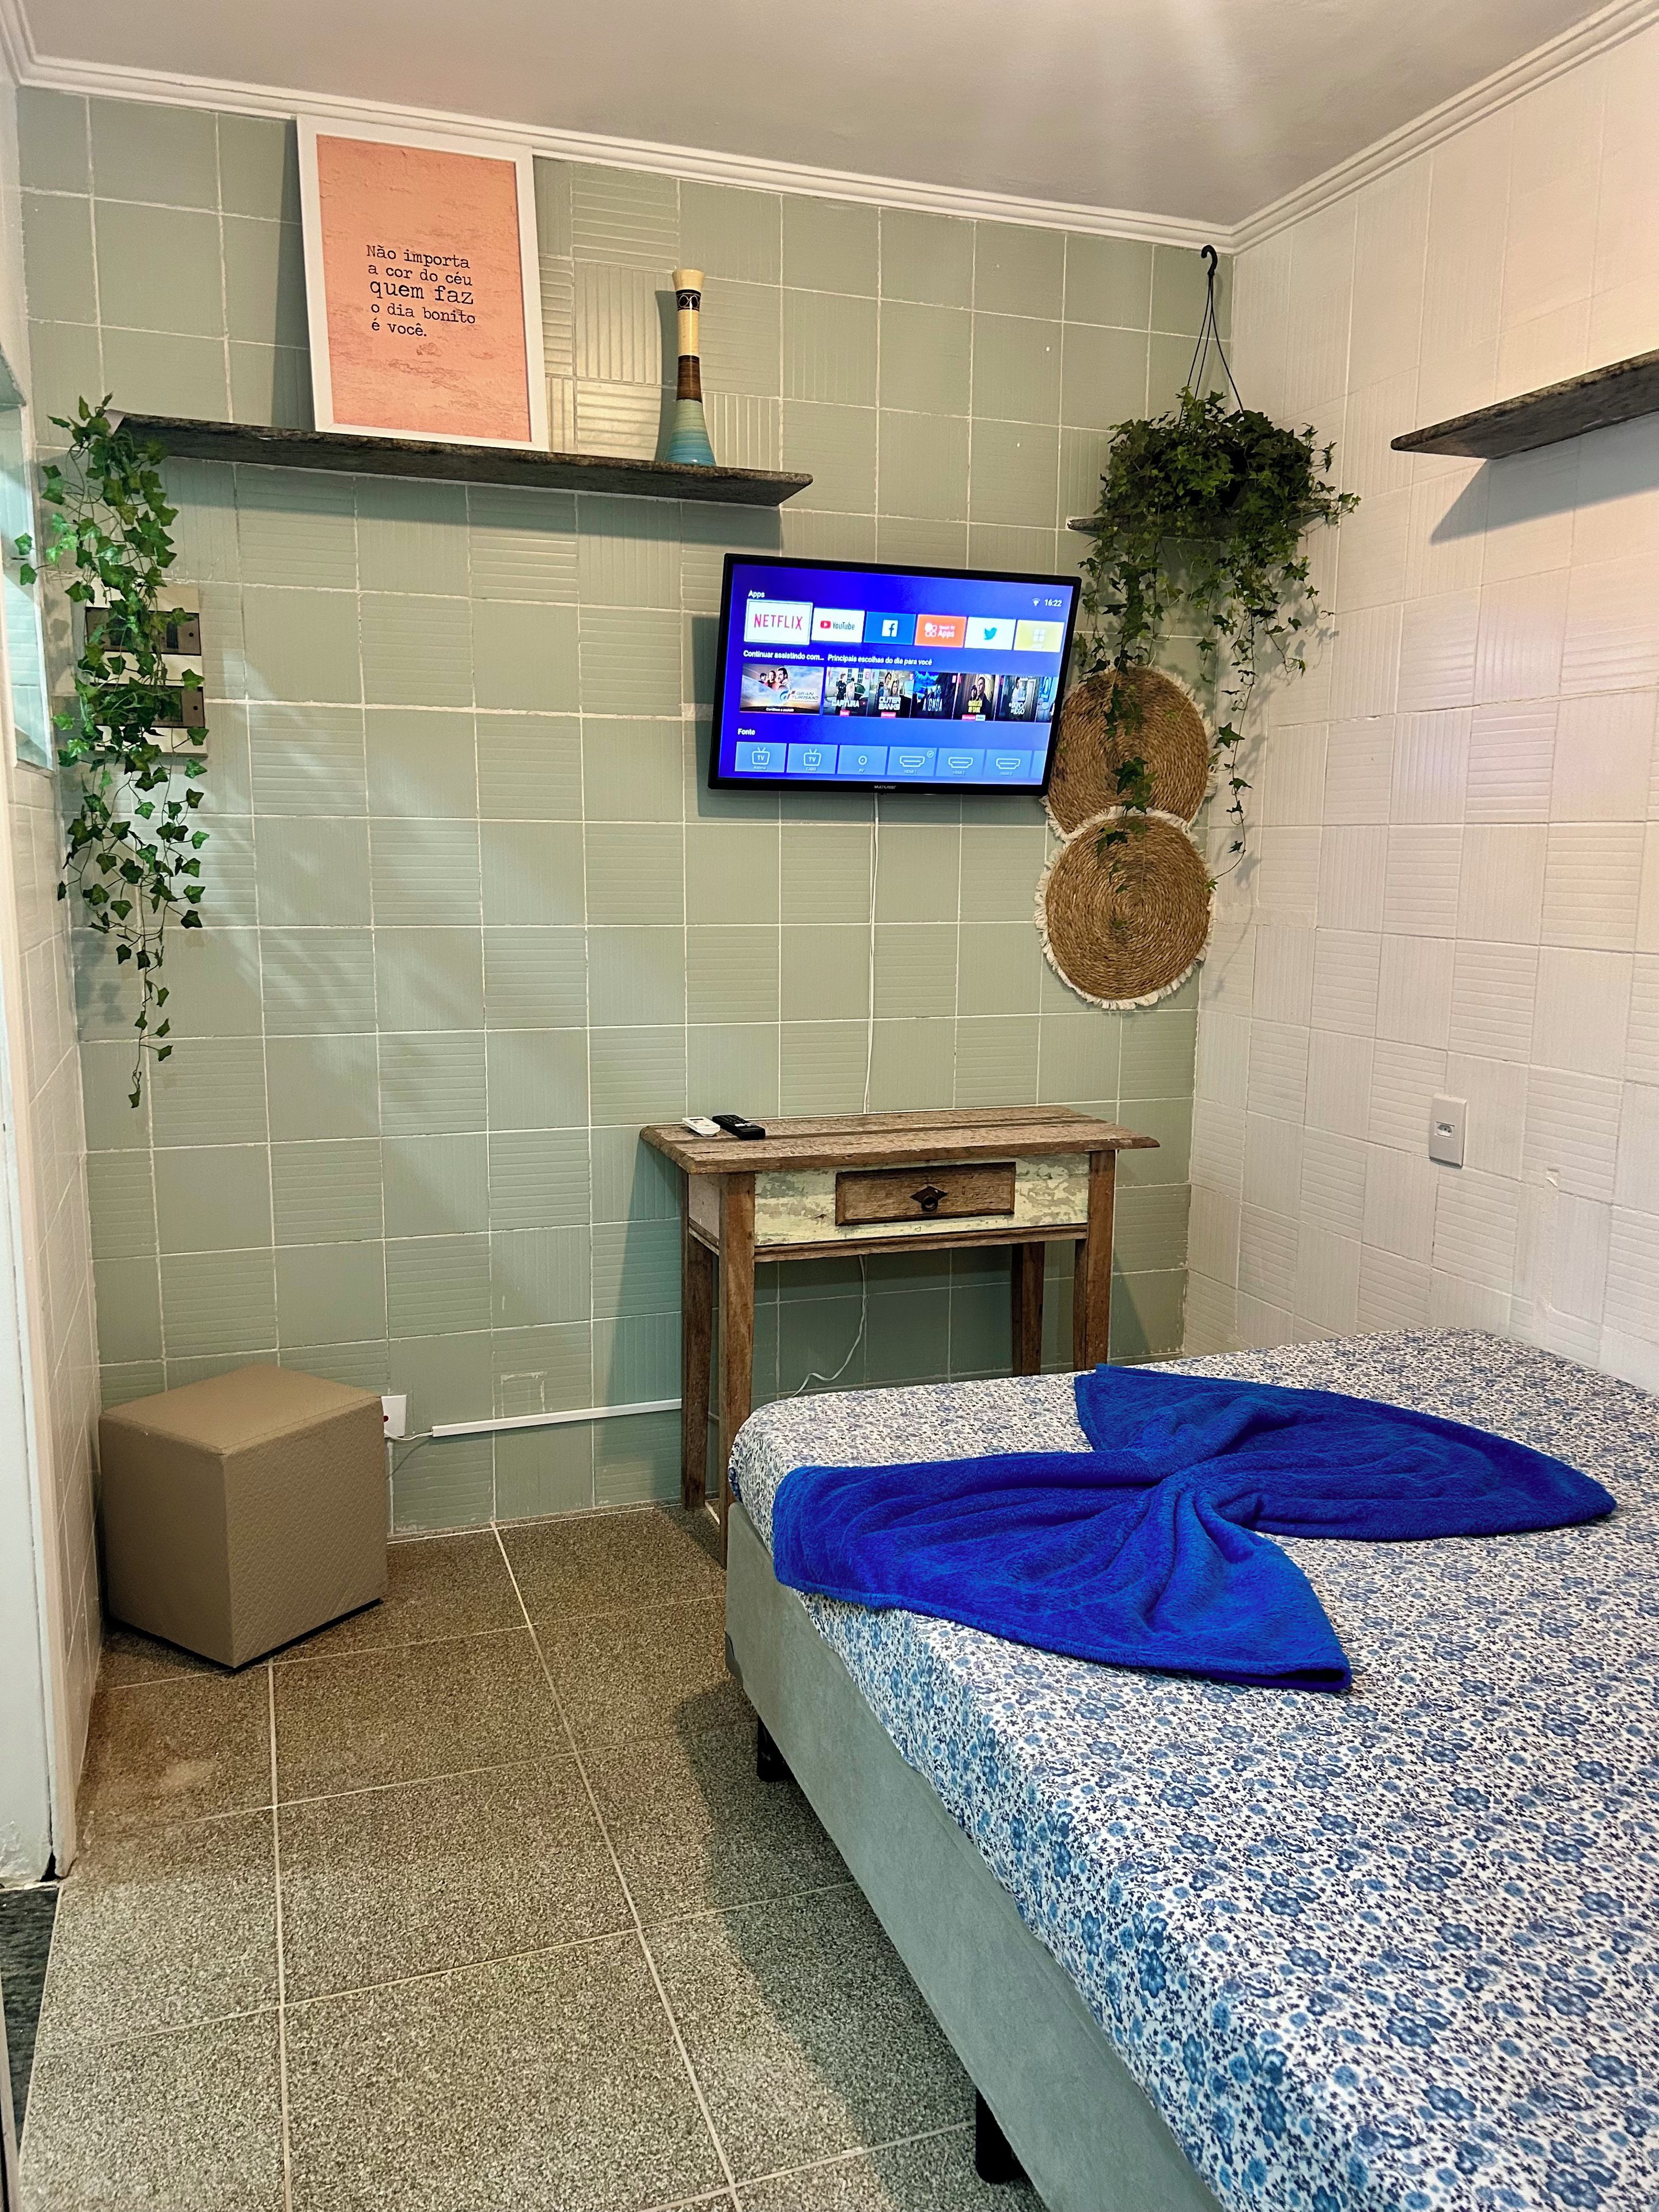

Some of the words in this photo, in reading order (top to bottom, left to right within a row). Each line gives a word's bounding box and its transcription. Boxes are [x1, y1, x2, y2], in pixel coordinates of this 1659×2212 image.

[366, 244, 396, 260] Não
[403, 249, 471, 269] importa
[368, 264, 378, 275] a
[386, 267, 412, 279] cor
[420, 268, 438, 282] do
[445, 271, 472, 286] céu
[370, 281, 425, 299] quem
[435, 285, 474, 305] faz
[371, 304, 380, 313] o
[387, 302, 415, 317] dia
[422, 307, 475, 324] bonito
[372, 317, 380, 331] é
[387, 323, 427, 336] você.
[748, 590, 765, 599] Apps
[1044, 599, 1062, 607] 16:22
[754, 613, 803, 630] NETFLIX
[833, 622, 855, 630] YouTube
[938, 630, 955, 638] Apps
[743, 650, 773, 658] Continuar
[774, 652, 805, 660] assistindo
[828, 654, 857, 663] Principais
[858, 656, 884, 664] escolhas
[832, 699, 859, 707] CAPTURA
[928, 698, 942, 712] ONDA
